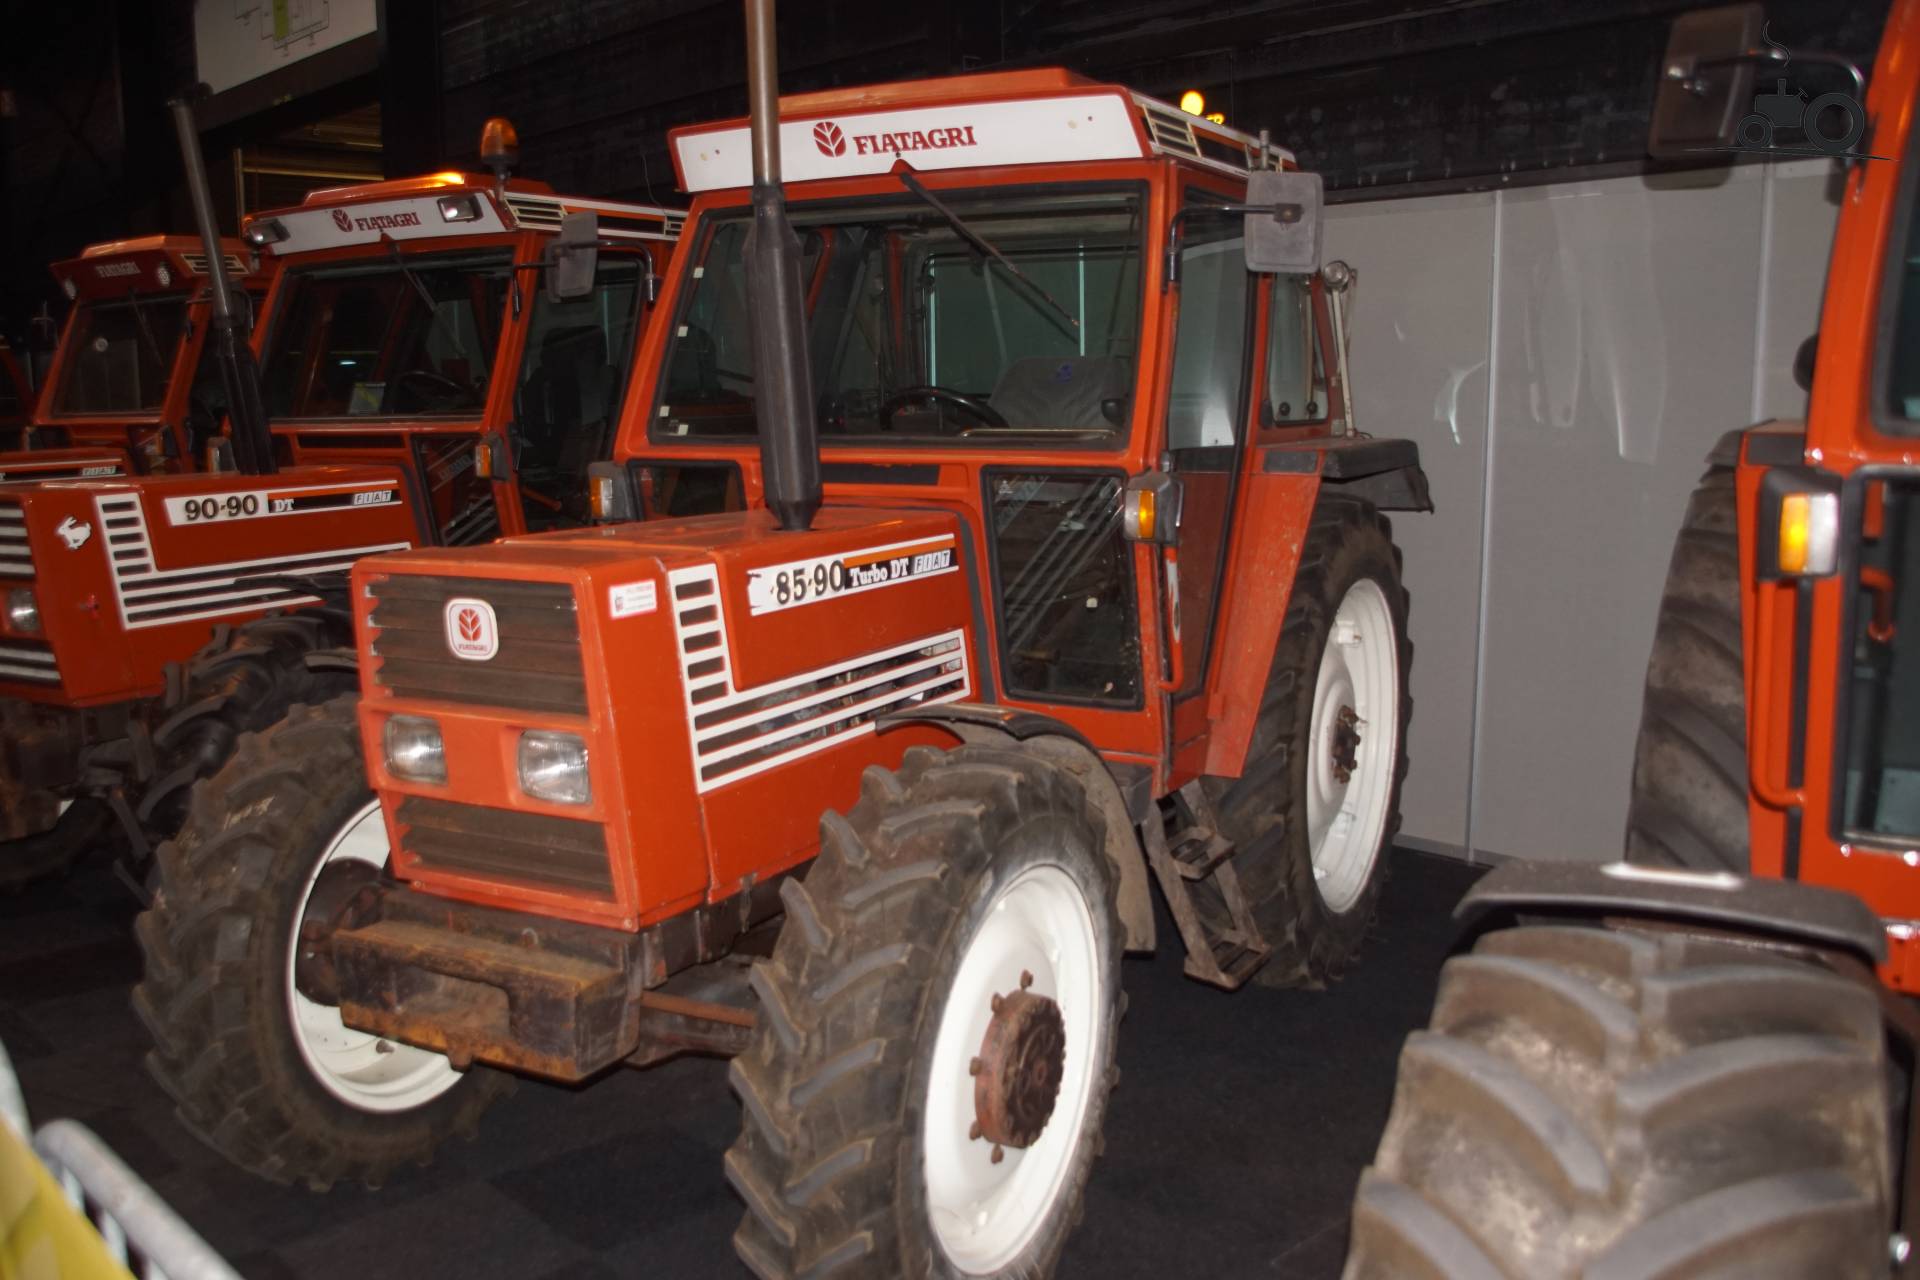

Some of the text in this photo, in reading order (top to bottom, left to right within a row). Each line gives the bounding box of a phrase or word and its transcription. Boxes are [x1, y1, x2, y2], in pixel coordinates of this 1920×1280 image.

[853, 126, 977, 155] FIATAGRI
[355, 212, 422, 231] FIATAGRI
[184, 490, 392, 521] 90-90 DT FIAT
[775, 549, 951, 605] 85-90 Turbo DT FIAT
